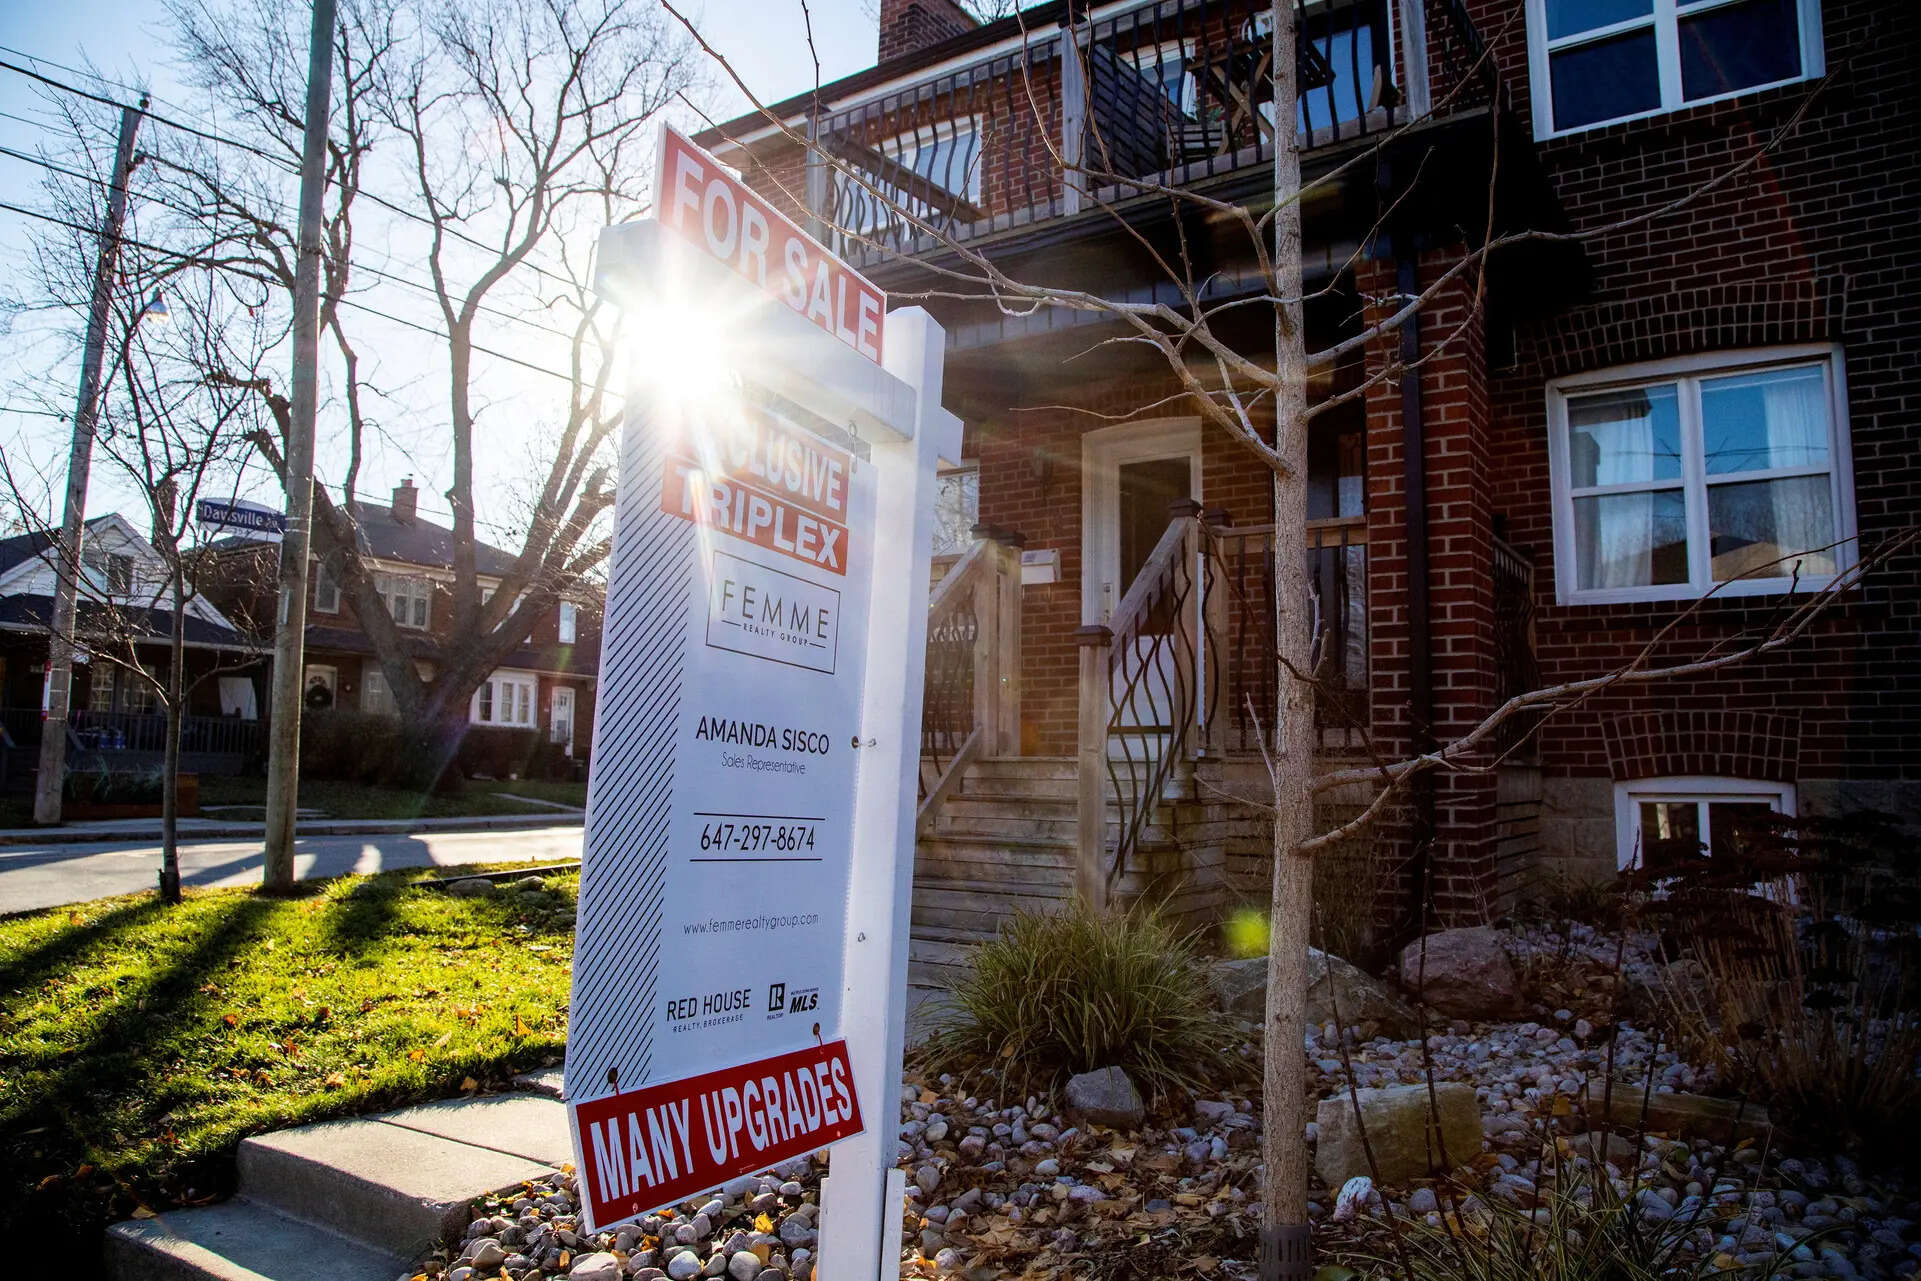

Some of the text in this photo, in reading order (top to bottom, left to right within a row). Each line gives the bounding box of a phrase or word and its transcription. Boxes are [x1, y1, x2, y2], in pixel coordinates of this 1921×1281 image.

[672, 149, 879, 362] FOR SALE
[204, 504, 263, 526] Davsville
[676, 465, 840, 569] TRIPLEX
[722, 580, 829, 639] FEMME
[743, 622, 808, 647] REALTY GROUP
[696, 716, 829, 755] AMANDA SISCO
[721, 751, 806, 774] Sales Representative
[700, 822, 815, 851] 647-297-8674
[683, 912, 819, 935] www.femmerealtygroup.com
[666, 989, 751, 1022] RED HOUSE
[789, 993, 818, 1014] MLS
[703, 1013, 744, 1029] BROKERAGE
[590, 1057, 852, 1203] MANY UPGRADES
